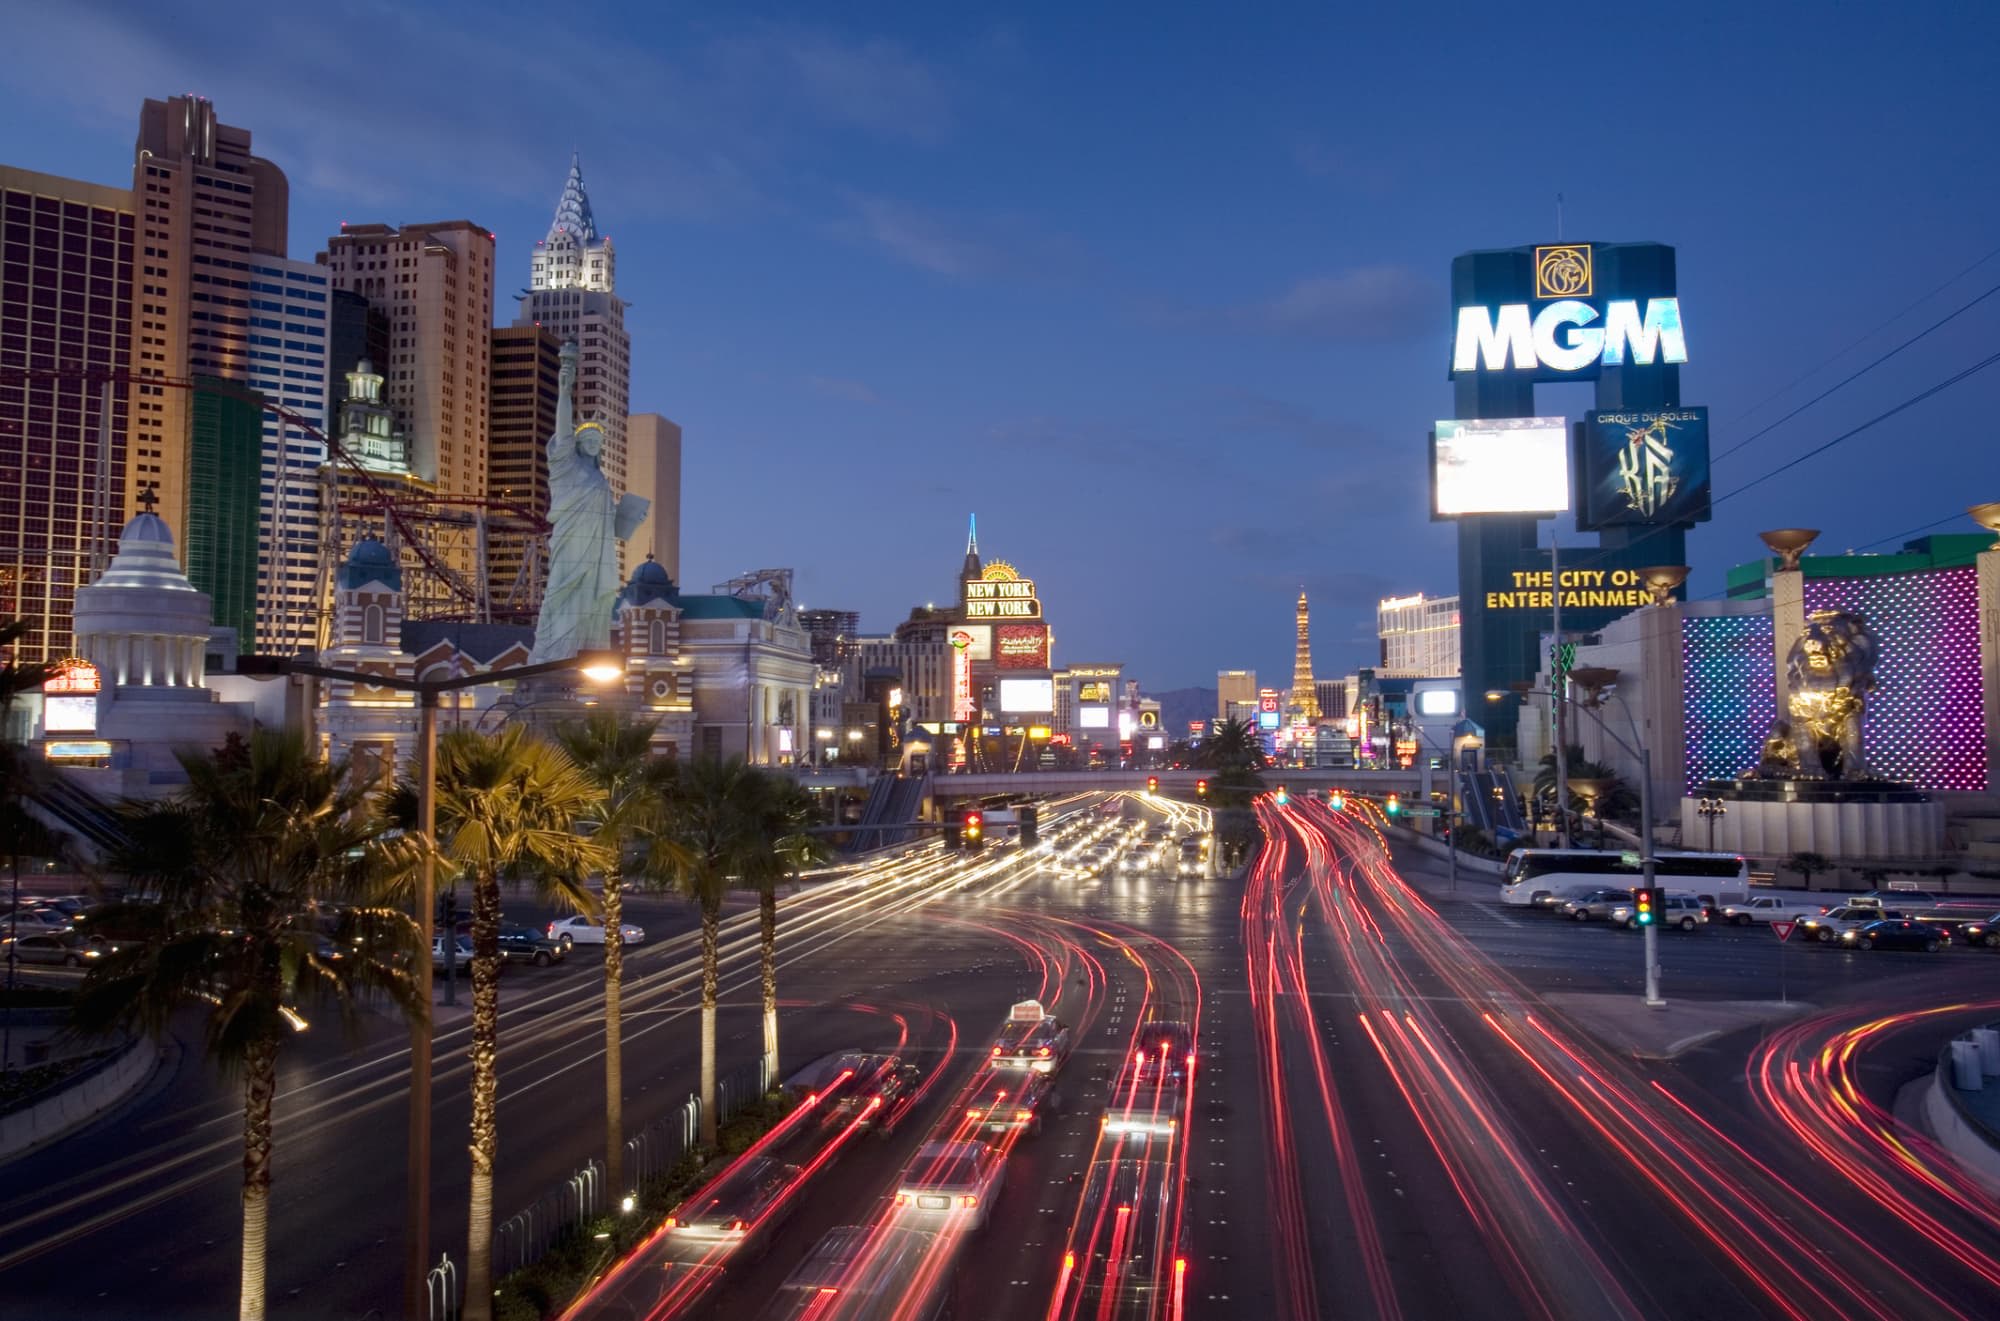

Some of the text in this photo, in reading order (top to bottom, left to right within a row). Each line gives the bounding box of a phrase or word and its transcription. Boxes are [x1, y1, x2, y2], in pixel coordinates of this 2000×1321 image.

[1453, 297, 1688, 371] MGM
[1598, 412, 1699, 425] CIRQUE DU SOLEIL
[1512, 571, 1553, 588] THE
[1559, 571, 1606, 587] CITY
[967, 583, 1031, 597] NEW YORK
[1487, 590, 1655, 608] ENTERTAINMEN
[967, 601, 1031, 615] NEW YORK
